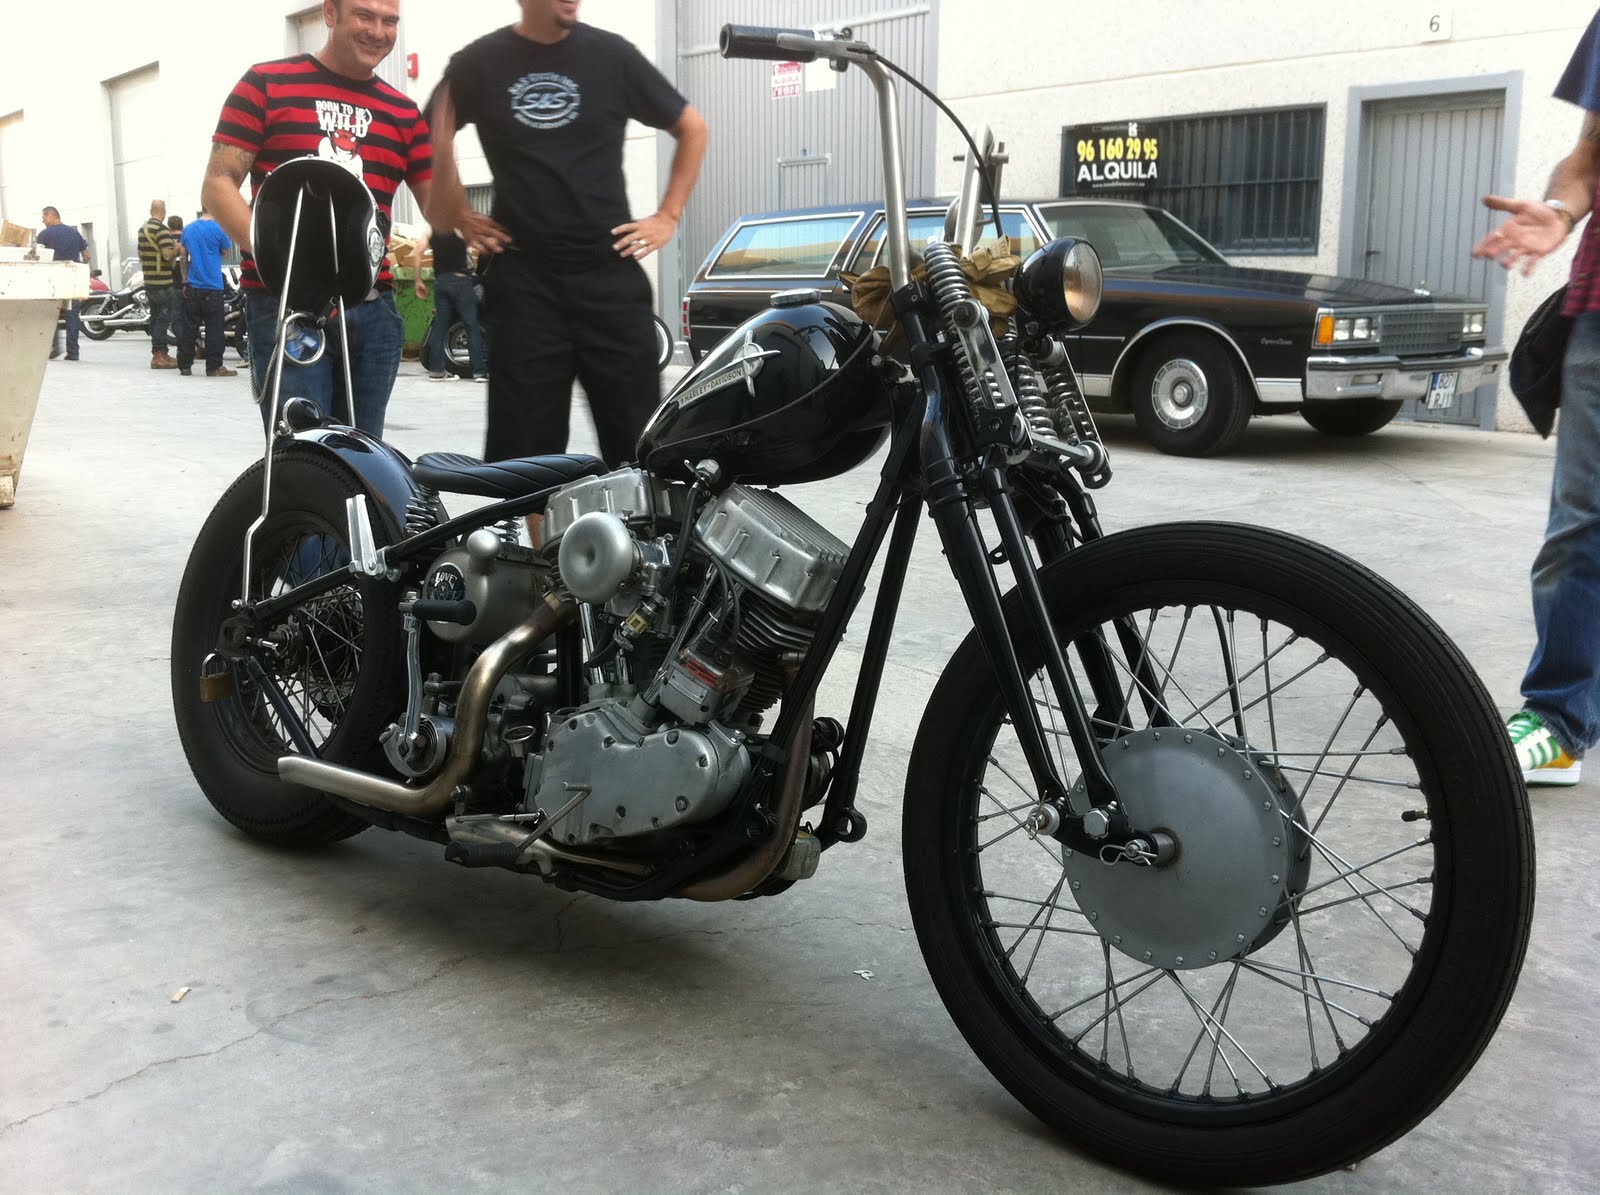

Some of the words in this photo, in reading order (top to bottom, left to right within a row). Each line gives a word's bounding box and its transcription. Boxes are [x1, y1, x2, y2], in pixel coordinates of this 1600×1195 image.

[1429, 14, 1440, 33] 6
[315, 100, 340, 113] BORN
[341, 103, 354, 115] TO
[355, 106, 367, 118] BE
[316, 109, 370, 138] WILD
[1077, 139, 1095, 162] 96
[1099, 137, 1124, 161] 160
[1126, 137, 1141, 160] 29
[1143, 137, 1158, 160] 95
[1077, 161, 1158, 182] ALQUILA
[684, 367, 743, 401] HARLEY-DAVIDSON
[434, 572, 458, 590] LOVE
